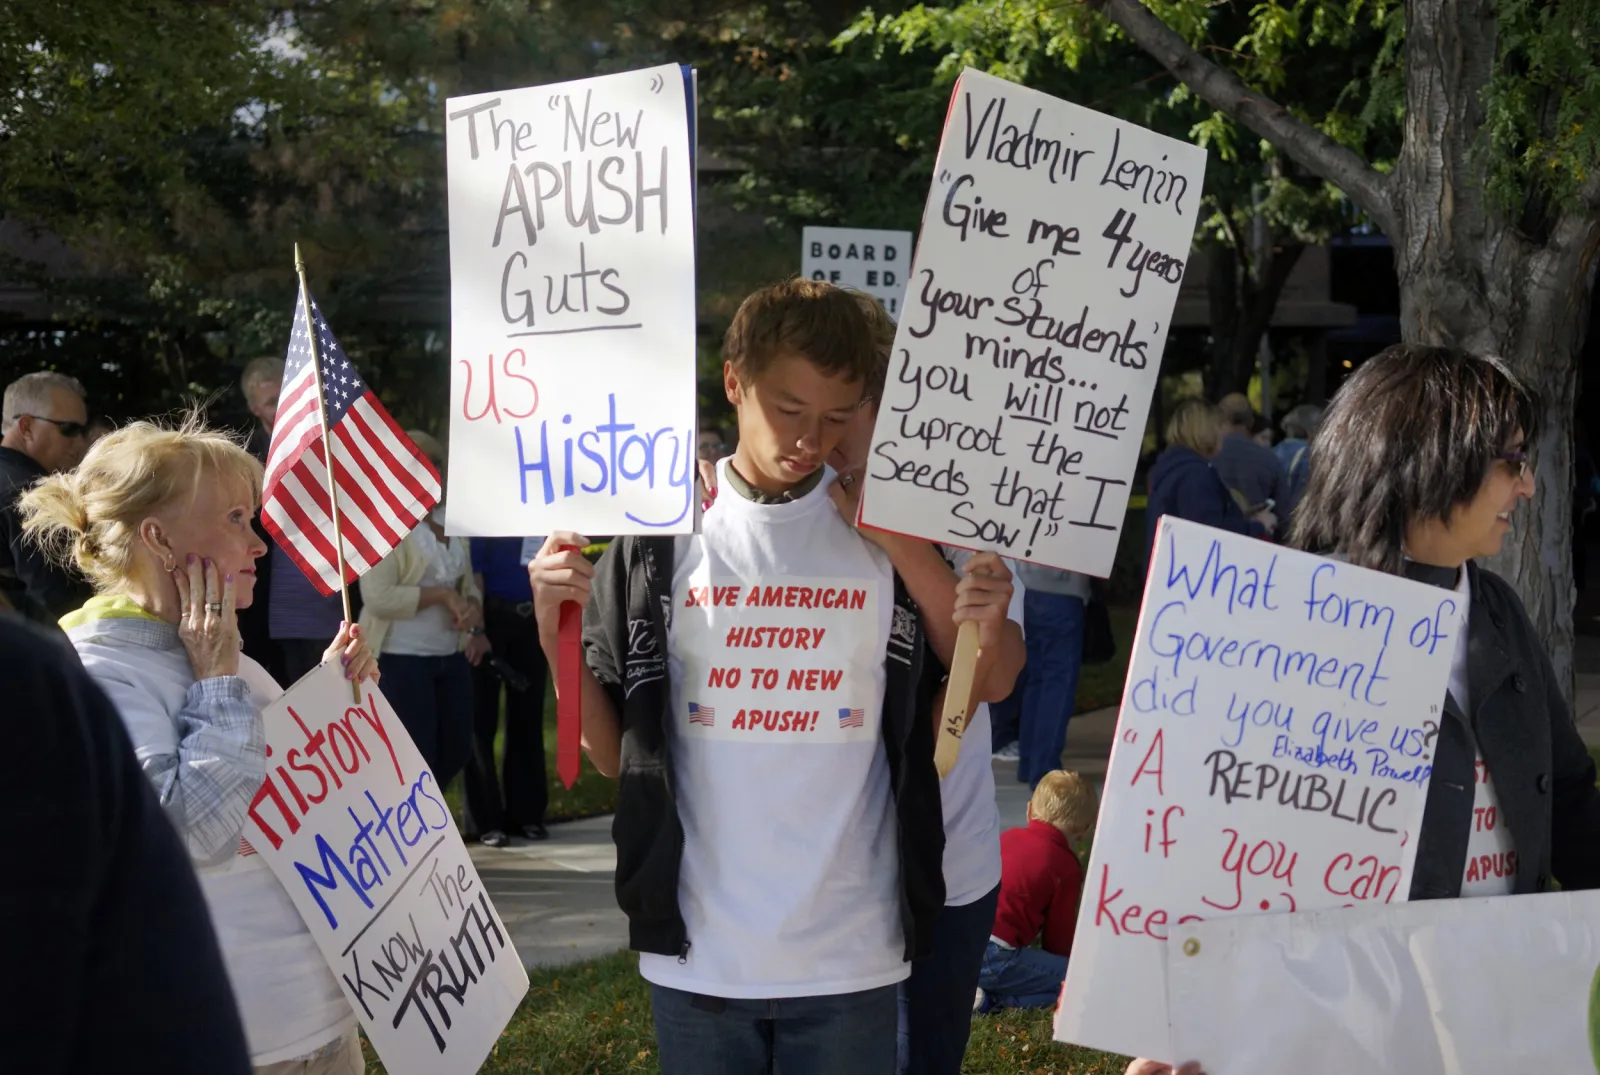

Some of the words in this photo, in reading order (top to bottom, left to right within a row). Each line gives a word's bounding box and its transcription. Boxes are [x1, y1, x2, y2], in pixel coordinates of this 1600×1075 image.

[449, 97, 537, 161] The
[965, 92, 1095, 184] Vladmir
[1100, 128, 1188, 215] Lenin
[492, 145, 668, 248] APUSH
[501, 241, 631, 328] Guts
[810, 242, 897, 261] BOARD
[1012, 259, 1055, 297] of
[1027, 218, 1081, 256] me
[1102, 208, 1136, 268] 4
[1119, 240, 1185, 298] years
[459, 348, 539, 425] US
[891, 348, 973, 412] you
[1004, 382, 1063, 423] will
[1074, 394, 1129, 432] not
[514, 393, 692, 527] History
[900, 415, 1006, 456] uproot
[1027, 430, 1083, 475] the
[990, 466, 1065, 521] that
[1068, 475, 1127, 531] I
[684, 585, 740, 608] SAVE
[745, 586, 866, 610] AMERICAN
[1304, 563, 1394, 646] form
[1409, 599, 1456, 655] of
[726, 626, 826, 650] HISTORY
[1149, 600, 1389, 706] Government
[708, 667, 741, 689] NO
[751, 668, 779, 690] TO
[786, 669, 843, 691] NEW
[731, 709, 820, 732] APUSH!
[1131, 666, 1198, 715] did
[1221, 692, 1293, 747] you
[1312, 706, 1379, 764] give
[1272, 735, 1357, 775] Elizabeth
[293, 770, 448, 930] Matters
[1474, 806, 1496, 832] TO
[419, 857, 473, 921] The
[1144, 805, 1184, 858] if
[1202, 828, 1298, 910] you
[1323, 853, 1401, 904] can
[1467, 850, 1519, 882] APUS
[392, 891, 505, 1054] TRUTH
